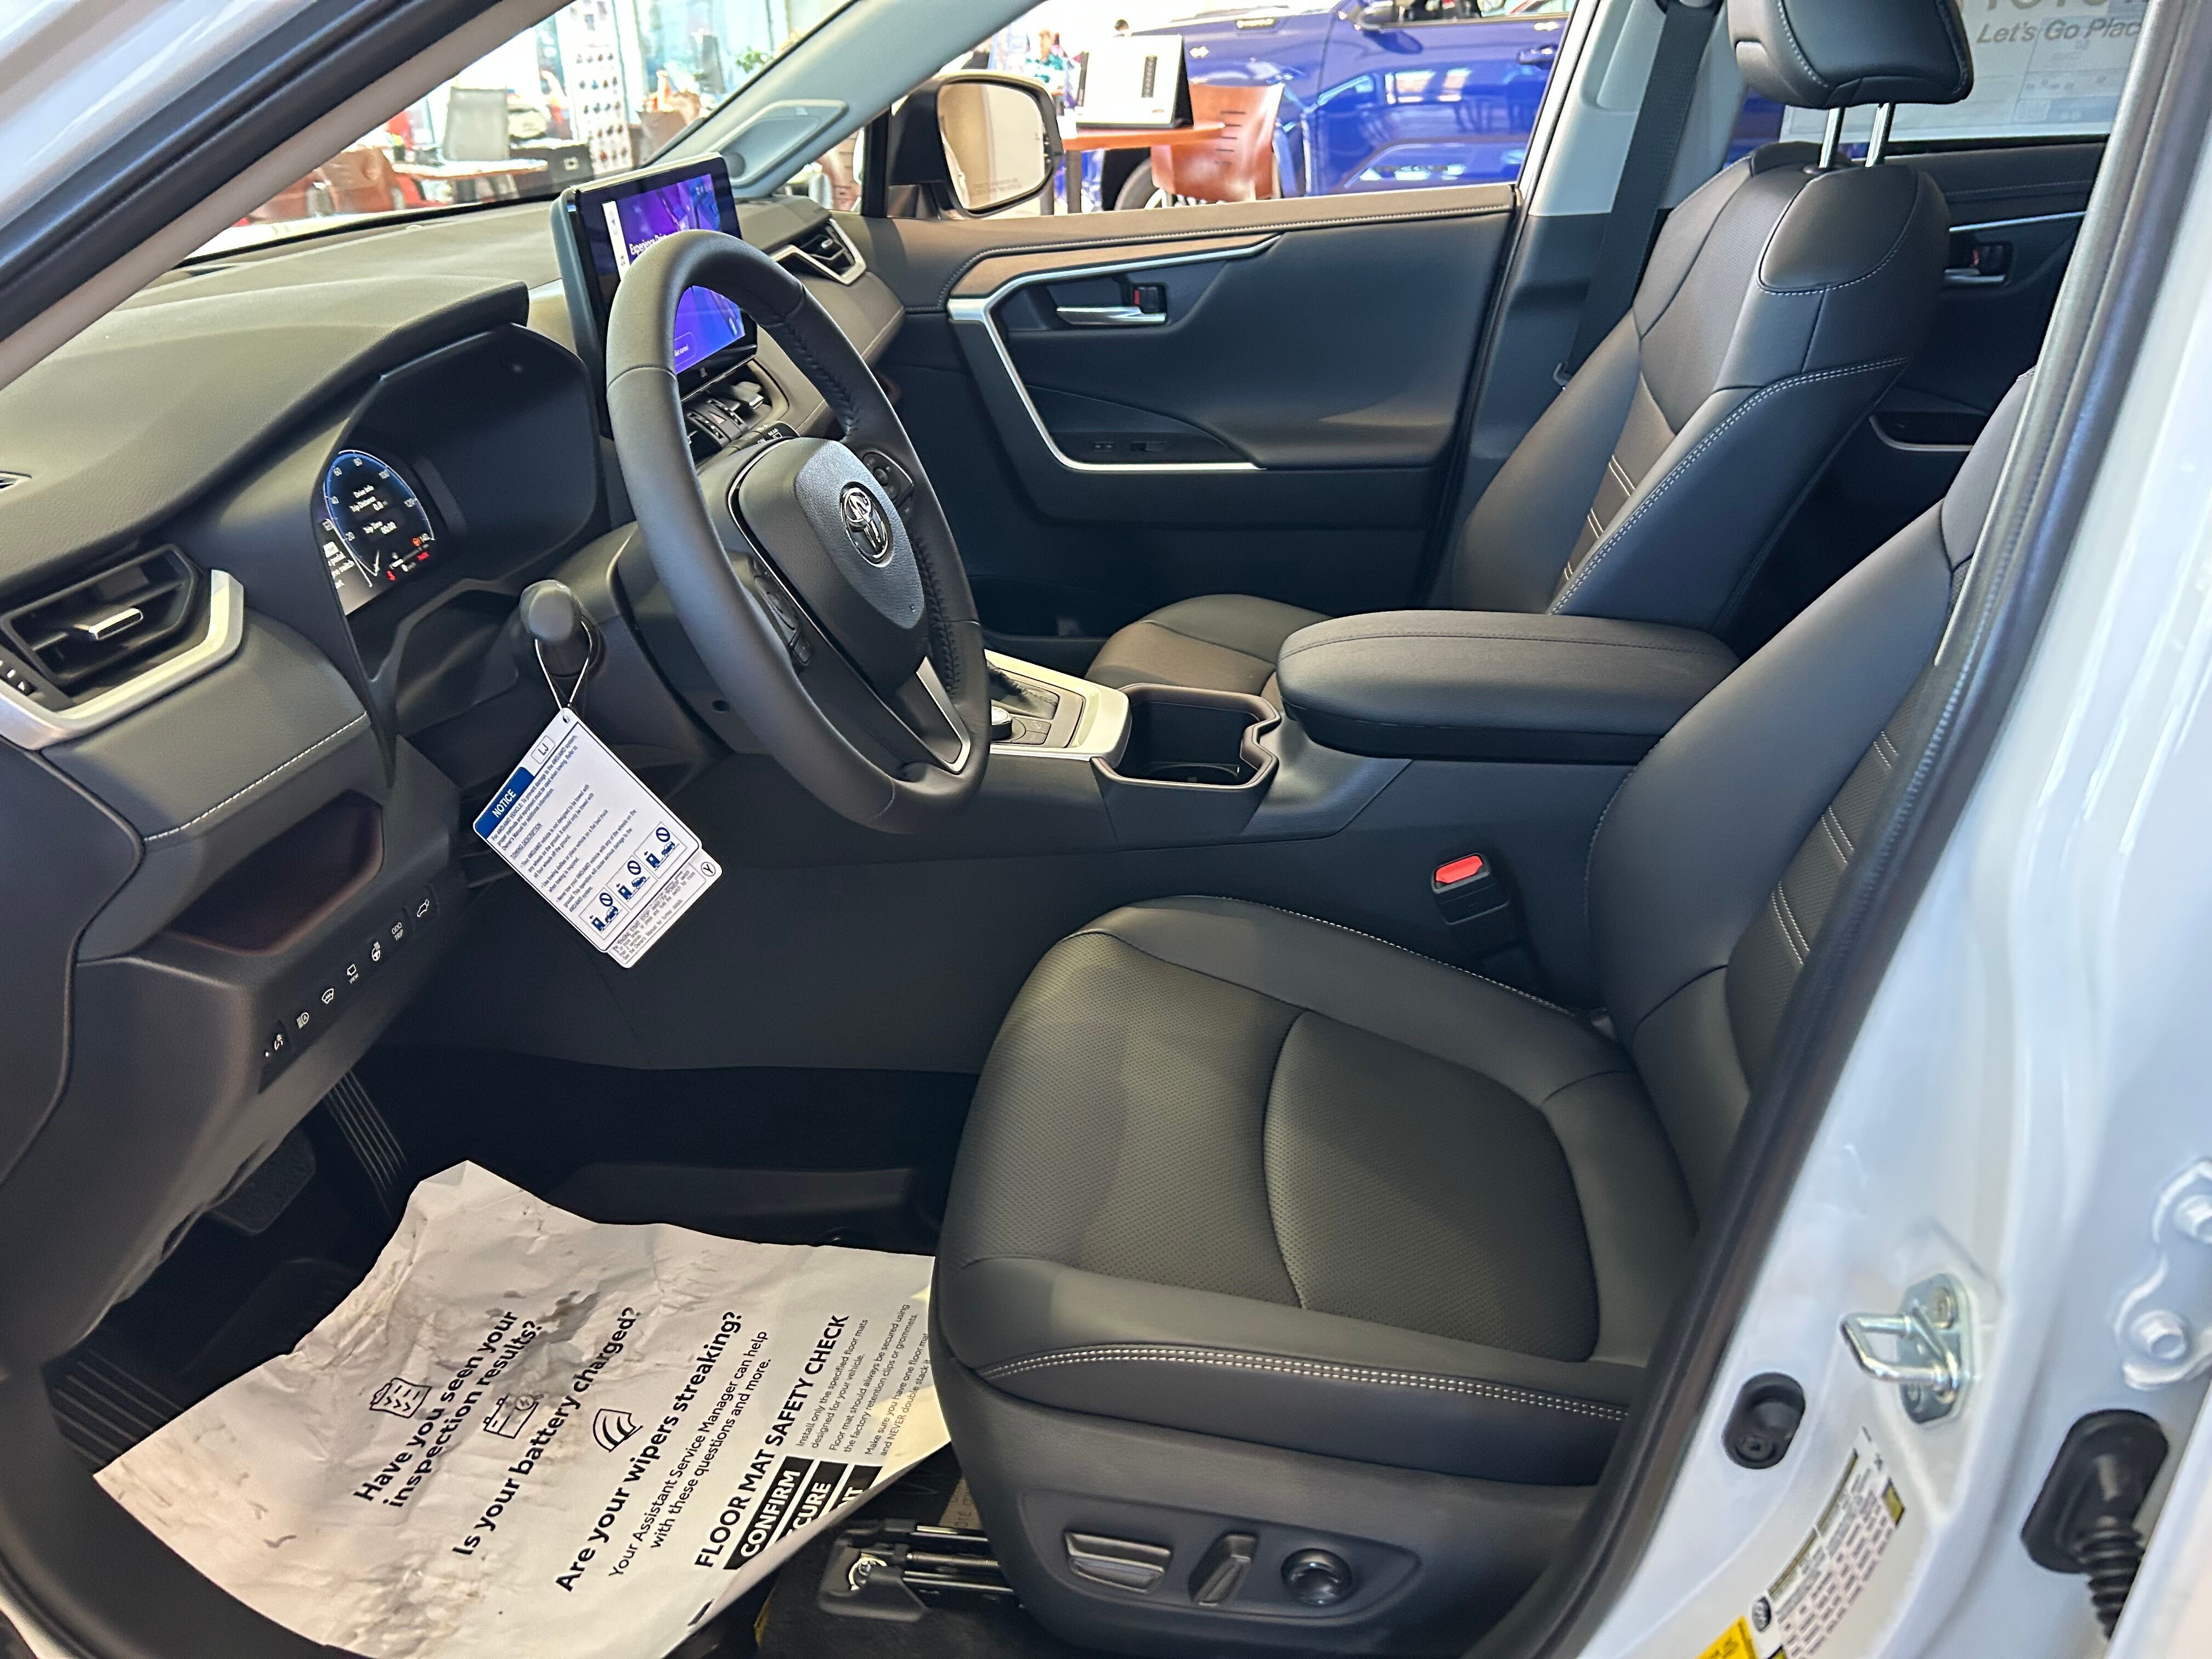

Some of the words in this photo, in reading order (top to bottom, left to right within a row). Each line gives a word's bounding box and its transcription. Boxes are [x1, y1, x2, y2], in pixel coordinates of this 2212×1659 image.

[1977, 21, 2038, 43] Let's
[2044, 19, 2081, 41] Go
[2084, 16, 2142, 40] Plac
[492, 789, 517, 817] NOTICE
[796, 1423, 815, 1446] Install
[811, 1405, 825, 1421] only
[820, 1391, 831, 1403] the
[828, 1357, 849, 1389] specified
[844, 1338, 857, 1355] floor
[855, 1319, 868, 1336] mats
[811, 1413, 834, 1448] designed
[829, 1400, 840, 1410] for
[837, 1382, 850, 1399] your
[847, 1354, 865, 1380] vehicle.
[829, 1431, 845, 1450] Floor
[842, 1415, 854, 1429] mat
[850, 1389, 867, 1413] should
[864, 1363, 879, 1387] always
[874, 1352, 884, 1361] be
[882, 1323, 899, 1350] secured
[895, 1305, 910, 1322] using
[844, 1440, 856, 1452] the
[850, 1412, 871, 1438] factory
[866, 1378, 887, 1410] retention
[883, 1361, 895, 1376] clips
[891, 1350, 899, 1358] or
[896, 1314, 917, 1349] grommets.
[891, 1383, 906, 1400] have
[904, 1367, 913, 1381] one
[909, 1347, 922, 1365] floor
[353, 1453, 413, 1501] Have
[407, 1408, 445, 1448] you
[441, 1357, 483, 1402] seen
[477, 1312, 517, 1353] your
[383, 1391, 482, 1506] inspection
[476, 1321, 548, 1385] results?
[452, 1536, 480, 1555] Is
[474, 1478, 520, 1531] your
[508, 1396, 580, 1475] battery
[573, 1307, 641, 1392] charged?
[556, 1548, 595, 1592] Are
[588, 1487, 630, 1543] your
[623, 1416, 679, 1482] wipers
[673, 1312, 741, 1412] streaking?
[695, 1497, 751, 1567] FLOOR
[738, 1449, 775, 1492] MAT
[765, 1378, 814, 1446] SAFETY
[805, 1316, 849, 1374] CHECK
[865, 1435, 881, 1454] Make
[878, 1417, 890, 1433] sure
[881, 1441, 892, 1455] and
[887, 1415, 906, 1440] NEVER
[901, 1386, 919, 1413] double
[916, 1366, 929, 1385] stack
[887, 1402, 898, 1416] you
[608, 1543, 637, 1576] Your
[633, 1480, 677, 1542] Assistant
[669, 1436, 705, 1477] Service
[698, 1381, 737, 1432] Manager
[734, 1360, 752, 1379] can
[743, 1332, 768, 1356] help
[651, 1519, 675, 1548] with
[668, 1479, 698, 1514] these
[694, 1419, 735, 1476] questions
[731, 1393, 751, 1415] and
[746, 1359, 771, 1390] more.
[740, 1470, 801, 1557] CONFIRM
[789, 1482, 831, 1534] CURE
